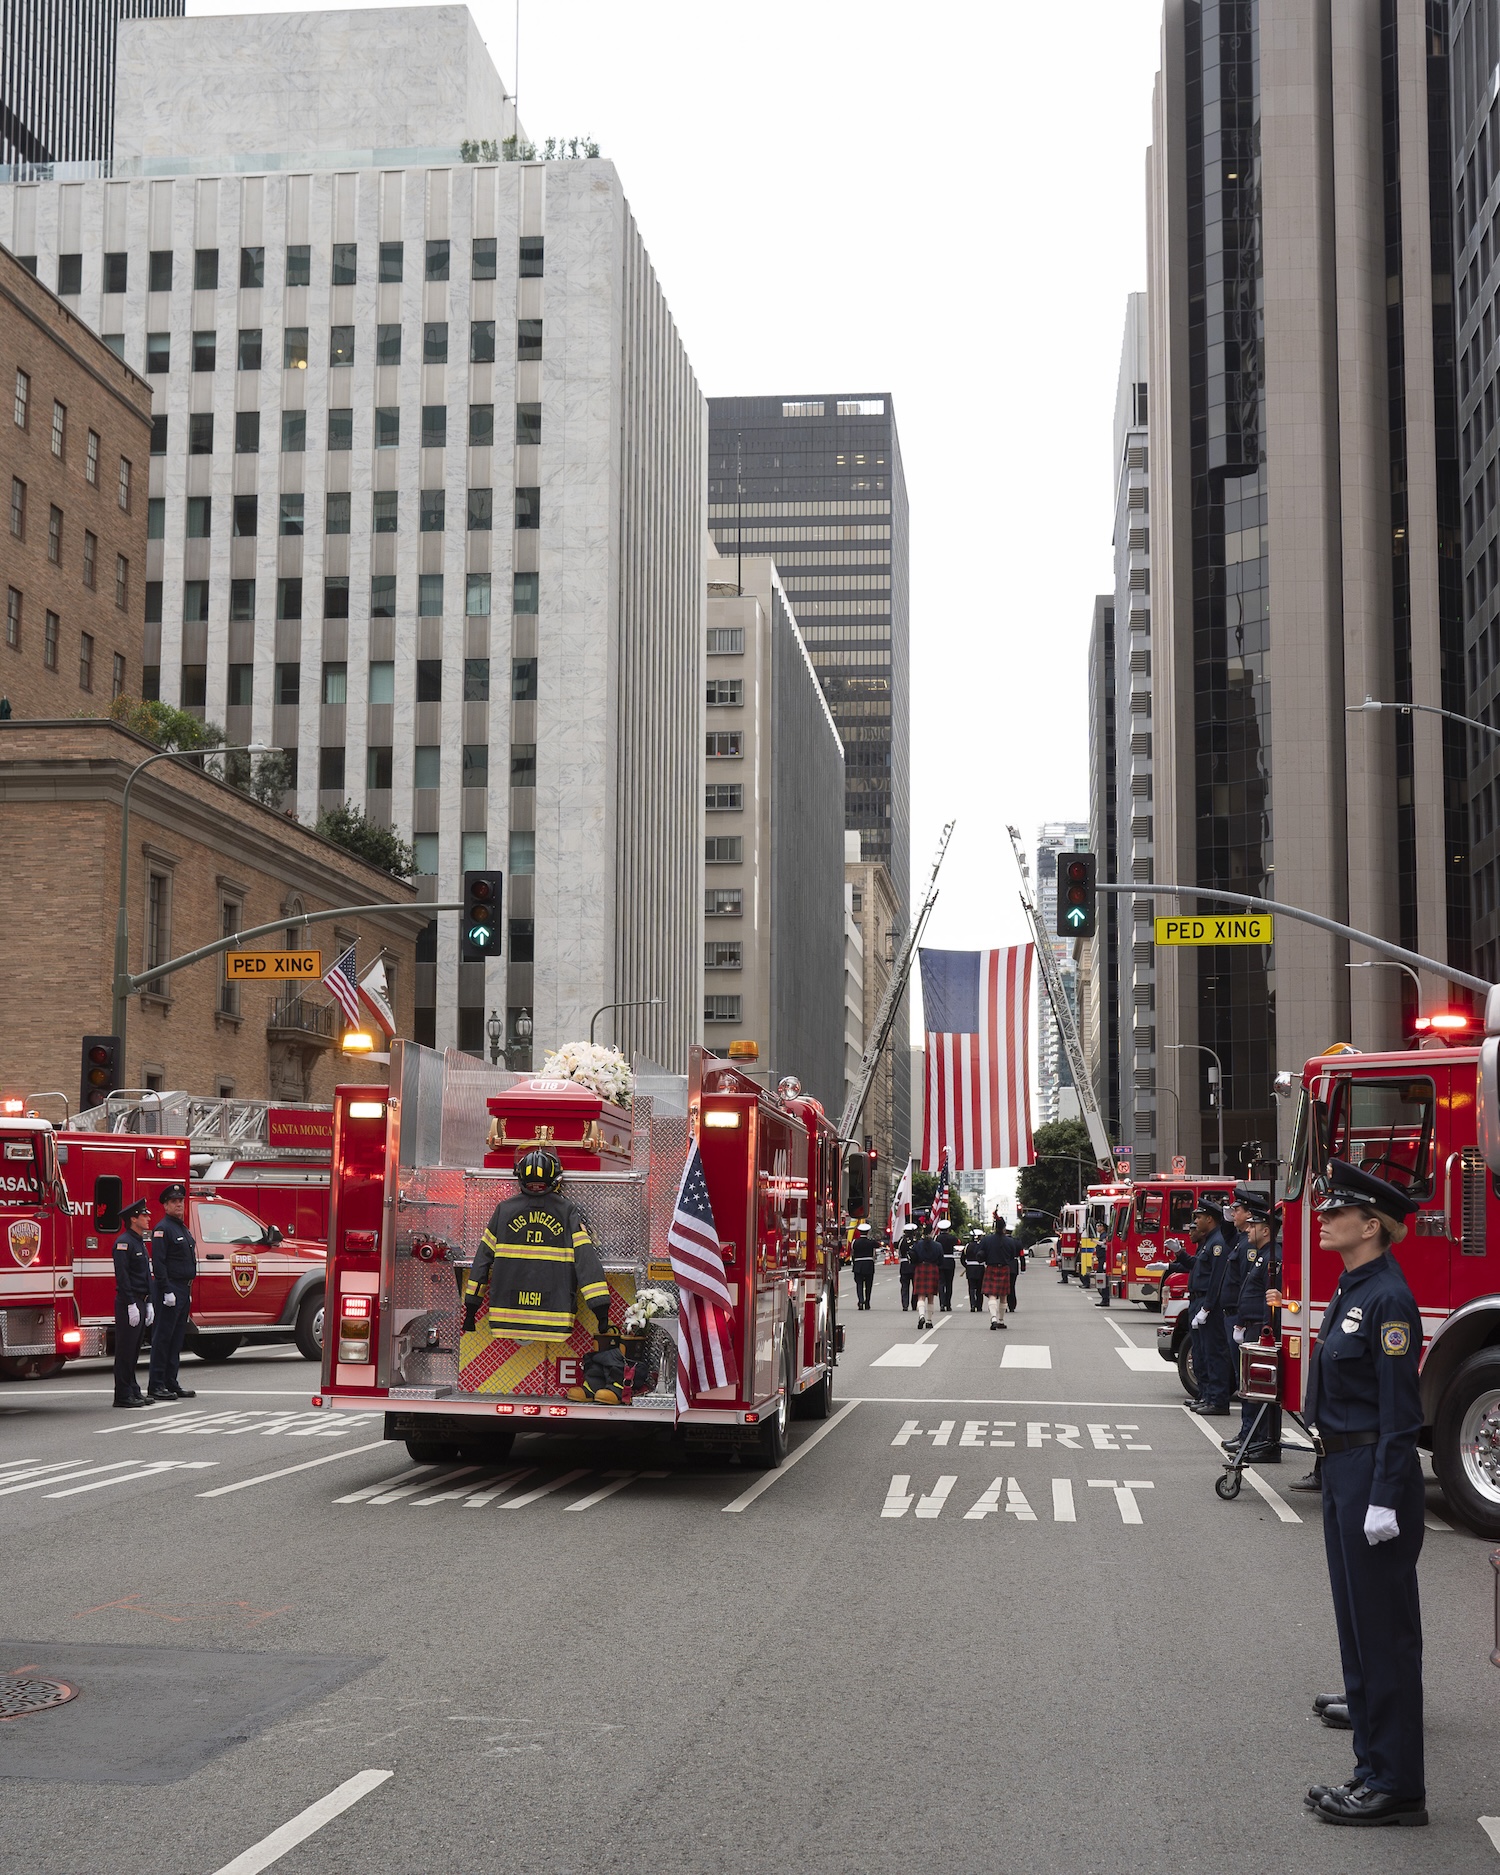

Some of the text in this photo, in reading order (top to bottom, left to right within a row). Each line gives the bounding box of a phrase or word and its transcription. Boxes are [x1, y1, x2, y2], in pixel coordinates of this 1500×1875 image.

[1166, 920, 1261, 939] PED XING
[233, 957, 314, 973] PED XING
[271, 1123, 333, 1137] SANTA MONICA
[11, 1223, 39, 1236] MOHAVE
[508, 1211, 565, 1237] LOS ANGELES
[526, 1230, 544, 1243] F.D.
[235, 1255, 253, 1264] FIRE
[518, 1290, 542, 1306] NASH
[890, 1420, 1153, 1450] HERE
[880, 1474, 1155, 1525] WAIT
